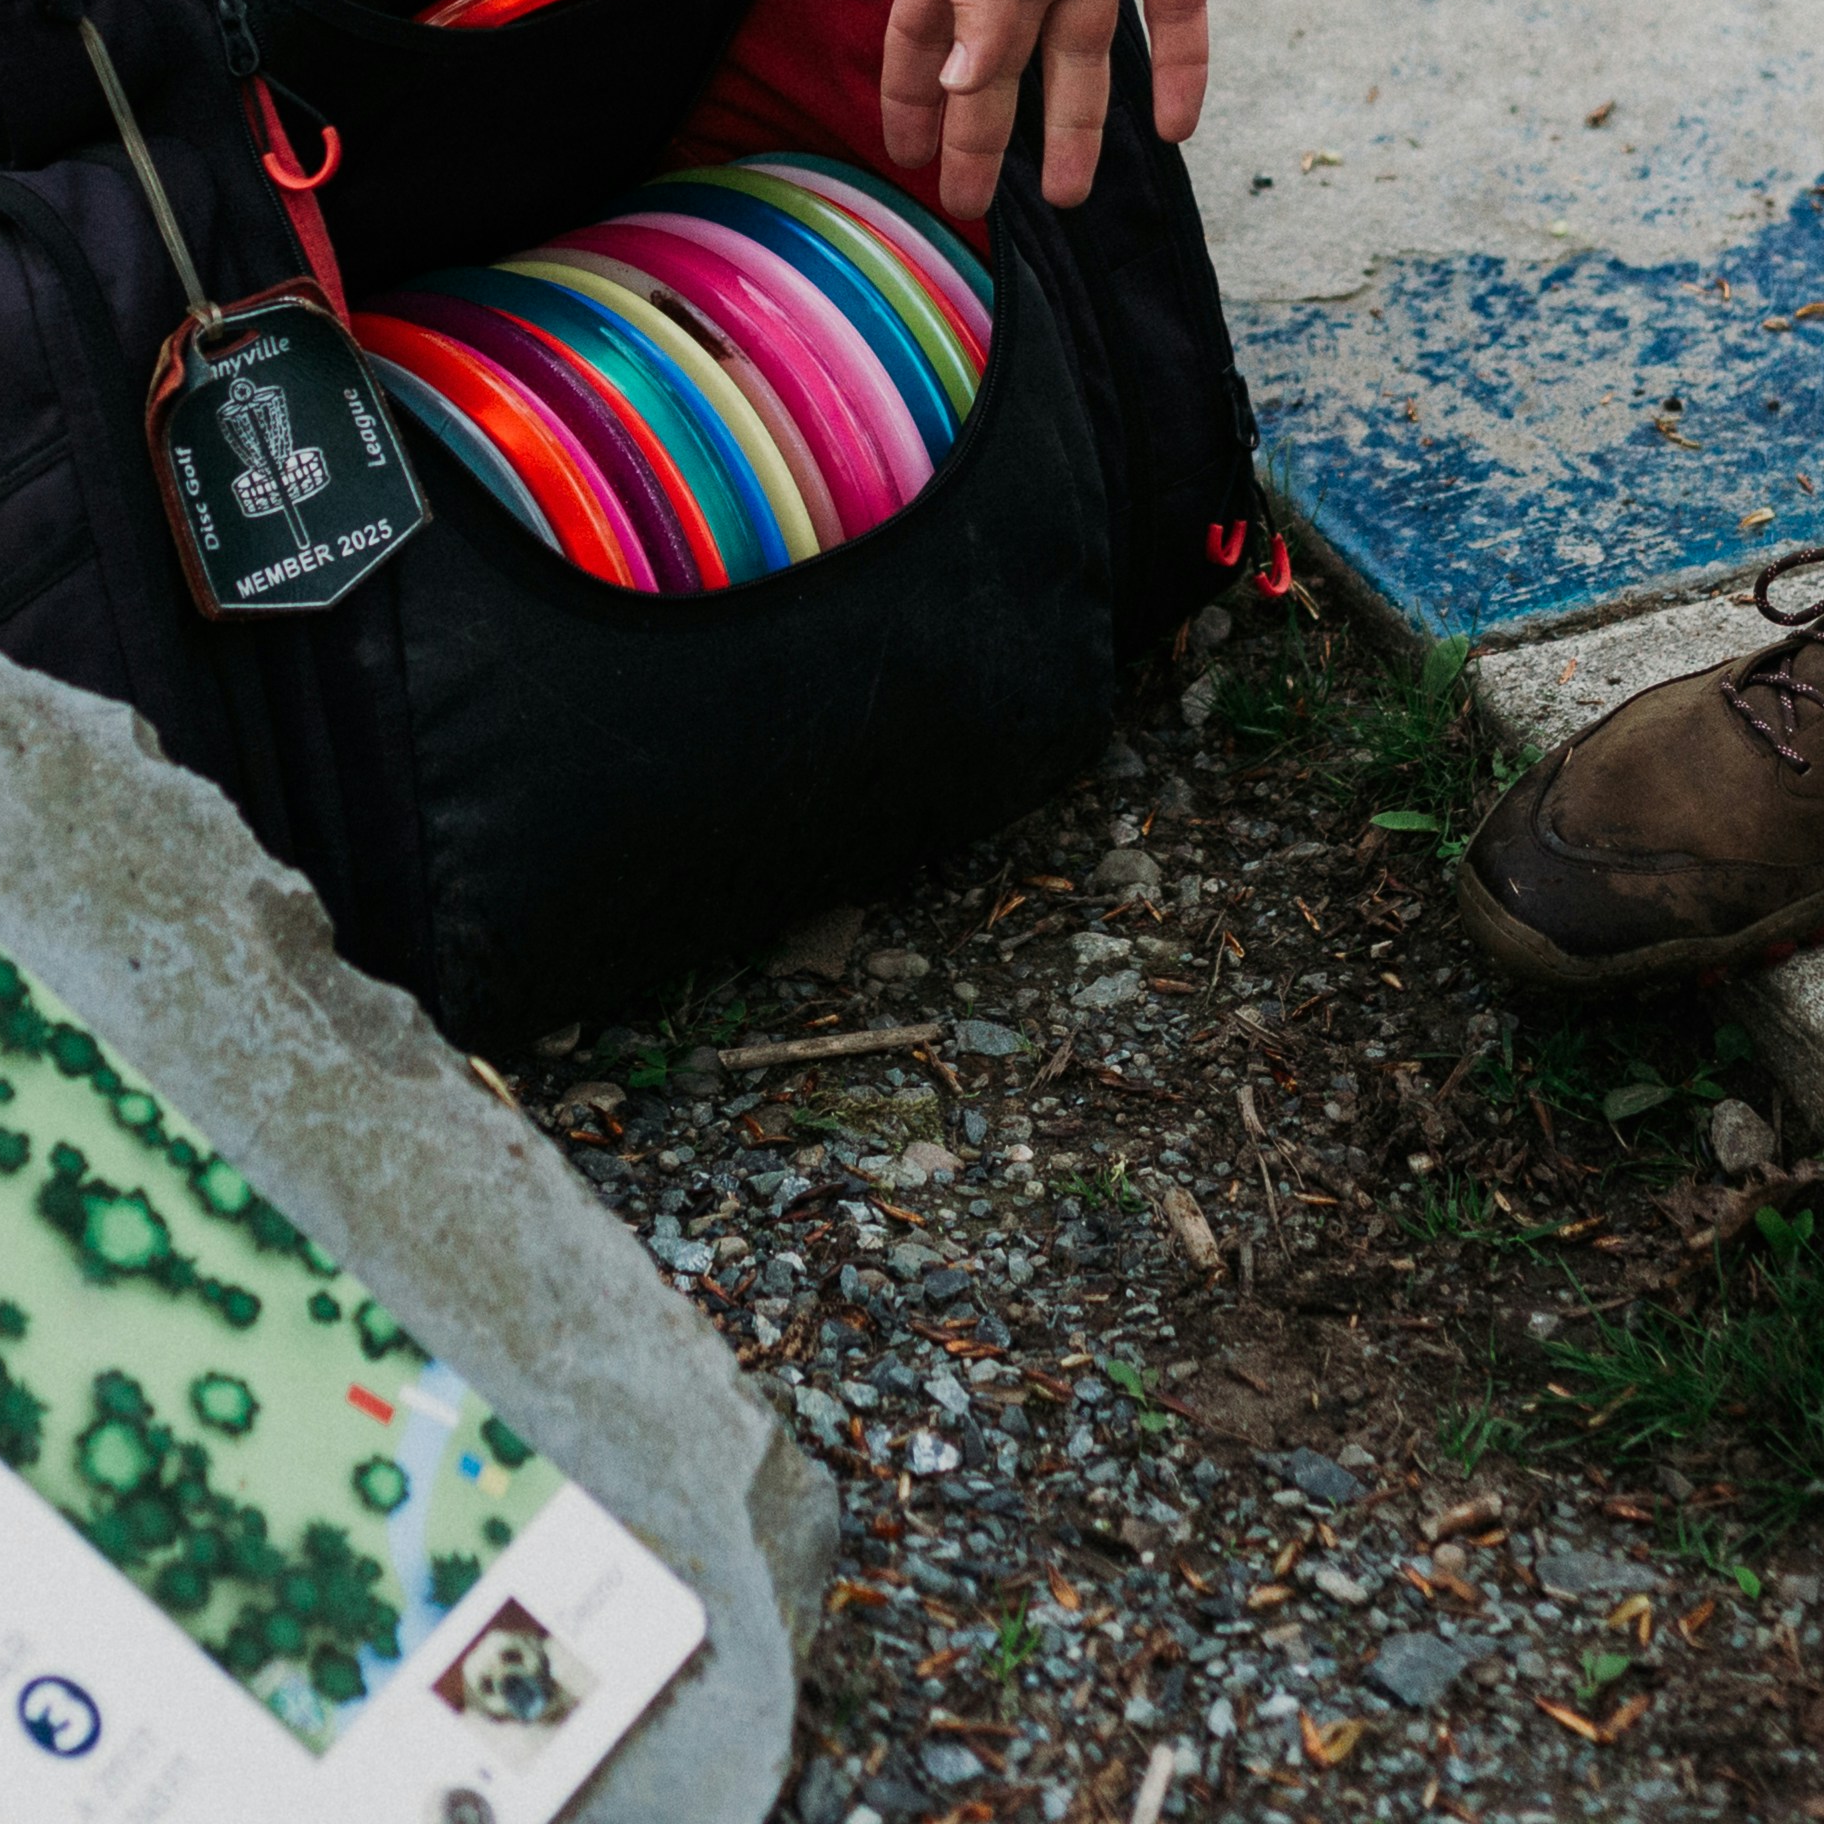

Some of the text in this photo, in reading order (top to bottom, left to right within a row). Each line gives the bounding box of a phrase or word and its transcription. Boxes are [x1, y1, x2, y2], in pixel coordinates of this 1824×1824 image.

[344, 389, 387, 467] League
[175, 447, 220, 551] Disc Golf
[235, 518, 393, 599] MEMBER 2025
